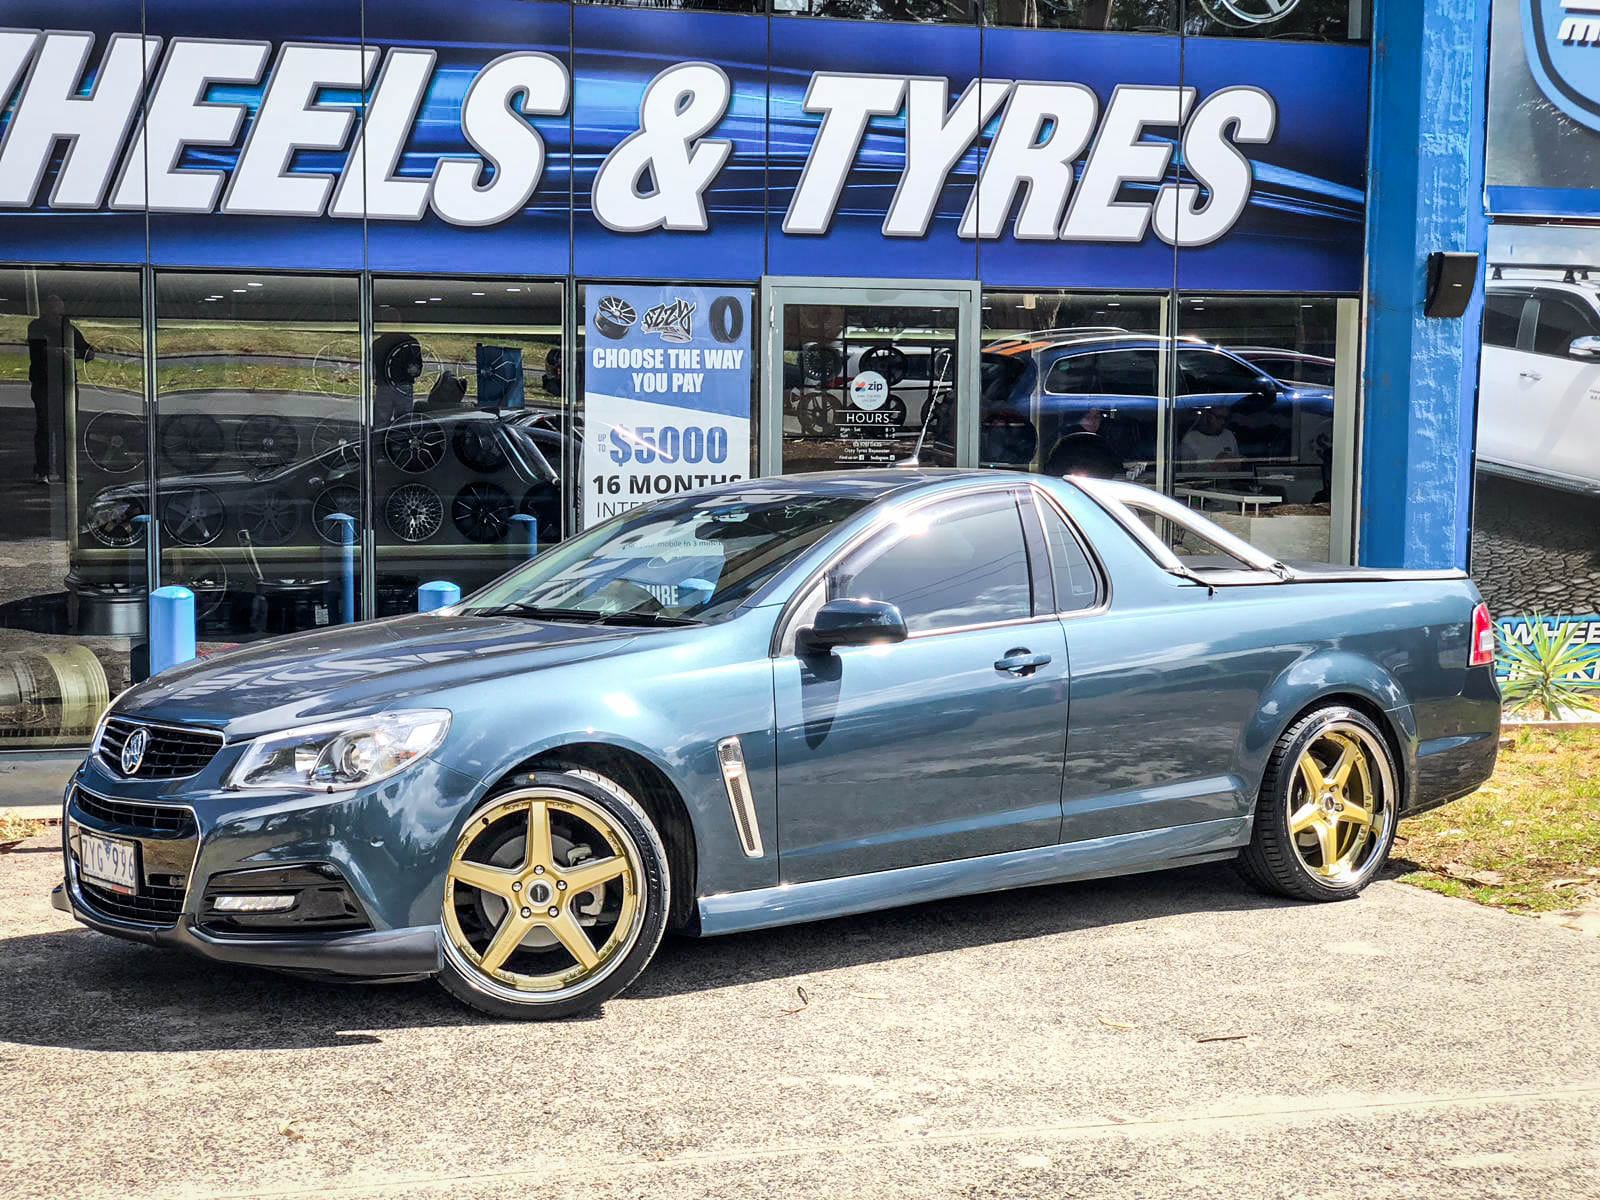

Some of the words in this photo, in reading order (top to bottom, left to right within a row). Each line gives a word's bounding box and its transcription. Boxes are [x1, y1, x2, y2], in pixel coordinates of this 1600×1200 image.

[0, 29, 570, 226] HEELS
[591, 61, 732, 232] &
[782, 71, 1277, 247] TYRES
[592, 348, 664, 369] CHOOSE
[667, 349, 700, 369] THE
[704, 349, 744, 370] WAY
[632, 373, 669, 393] YOU
[672, 373, 705, 393] PAY
[867, 381, 883, 392] zip
[846, 413, 890, 423] HOURS
[597, 433, 607, 442] UP
[610, 424, 728, 467] $5000
[598, 443, 606, 453] TO
[593, 475, 621, 494] 16
